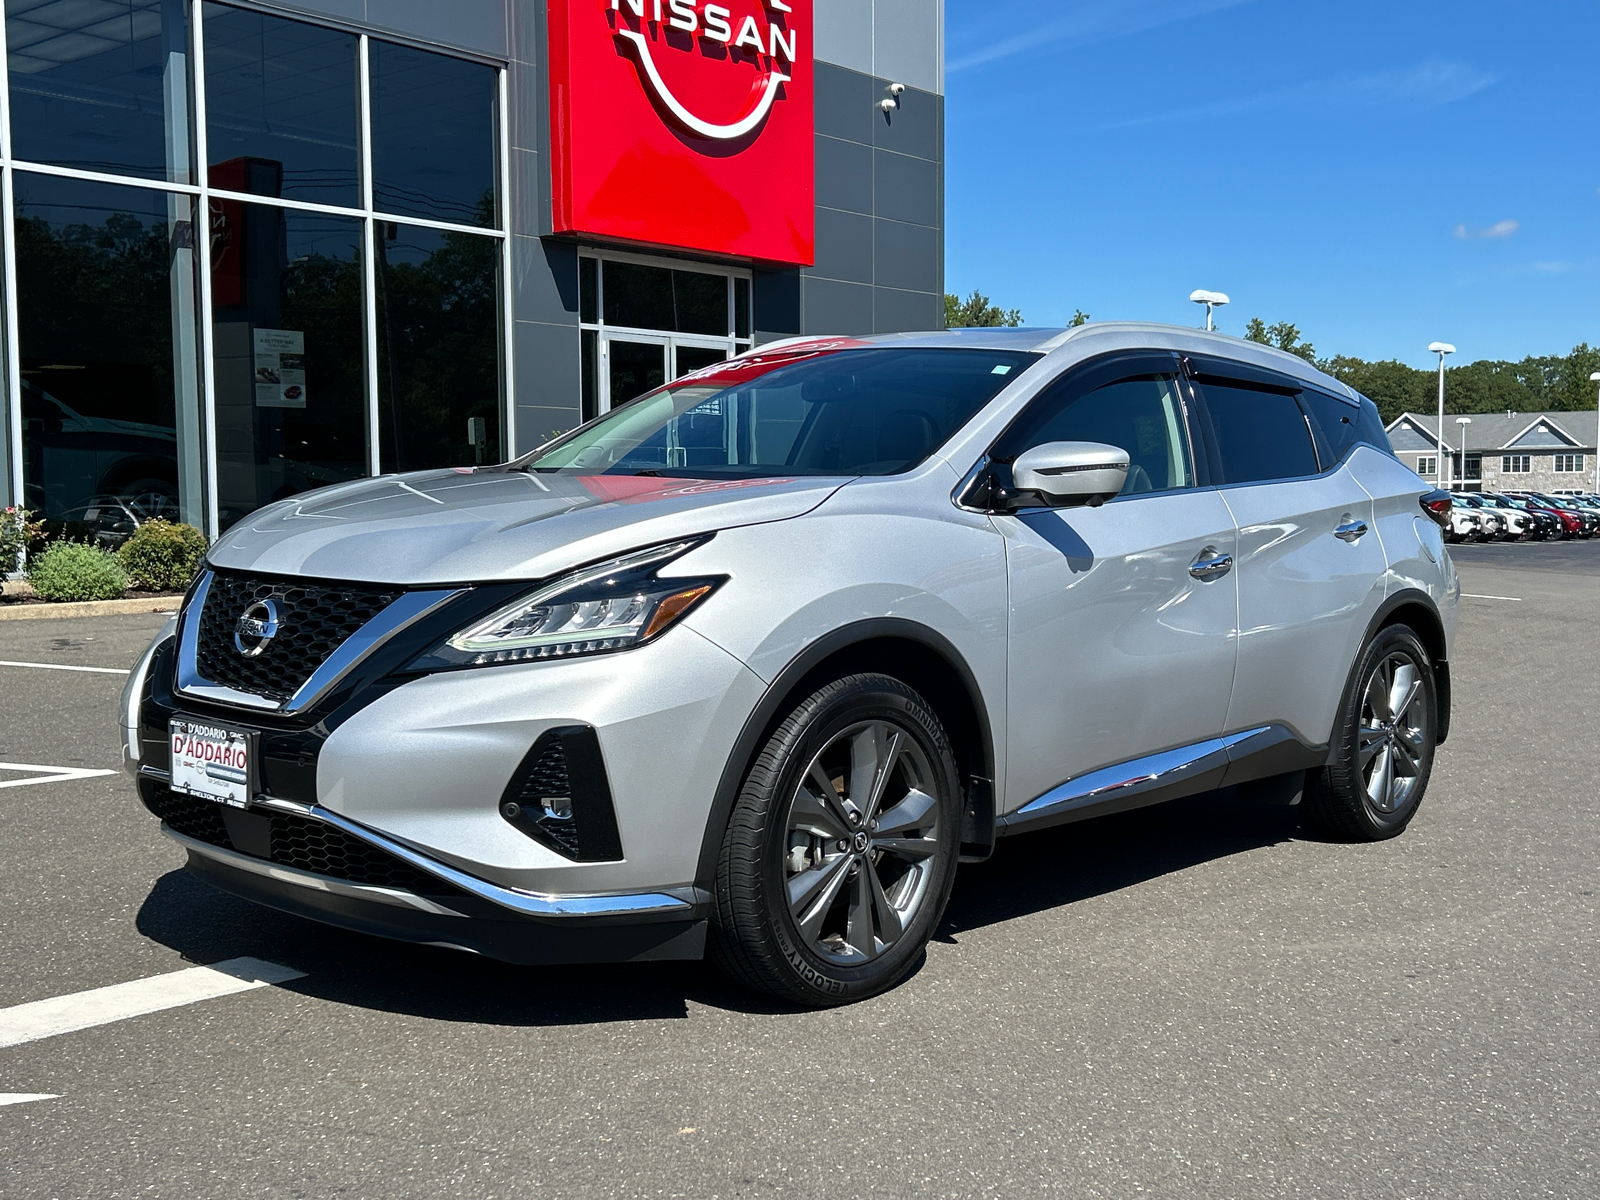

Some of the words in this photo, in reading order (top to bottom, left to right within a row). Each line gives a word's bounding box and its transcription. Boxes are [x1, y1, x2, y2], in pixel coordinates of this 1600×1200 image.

[188, 723, 226, 740] D'ADDARIO
[905, 700, 947, 757] OMNIMAX
[174, 735, 247, 769] D'ADDARIO
[787, 950, 849, 995] VELOCITY
